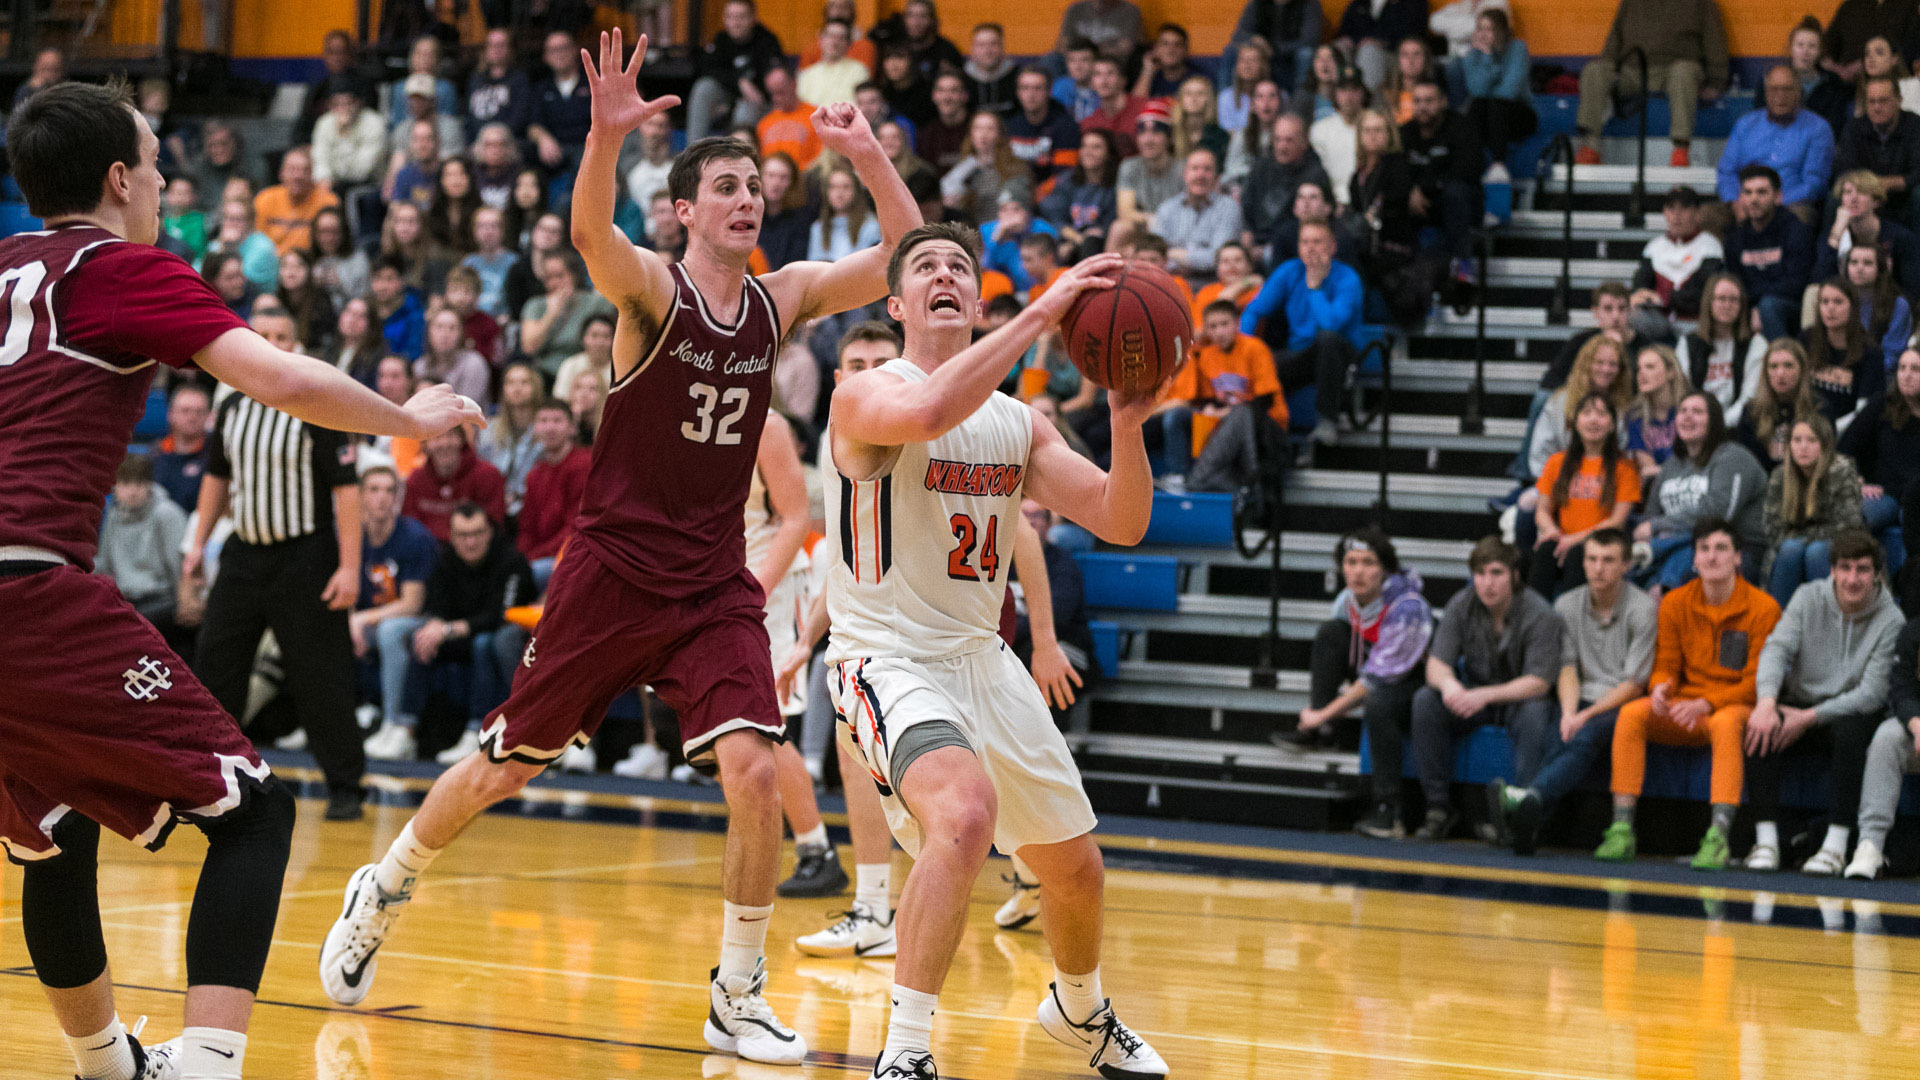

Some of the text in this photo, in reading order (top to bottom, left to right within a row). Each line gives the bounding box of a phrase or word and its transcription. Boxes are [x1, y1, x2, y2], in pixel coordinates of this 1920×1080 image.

[669, 338, 772, 375] North Central
[681, 382, 750, 445] 32
[924, 458, 1022, 497] WHEATON
[948, 513, 999, 582] 24
